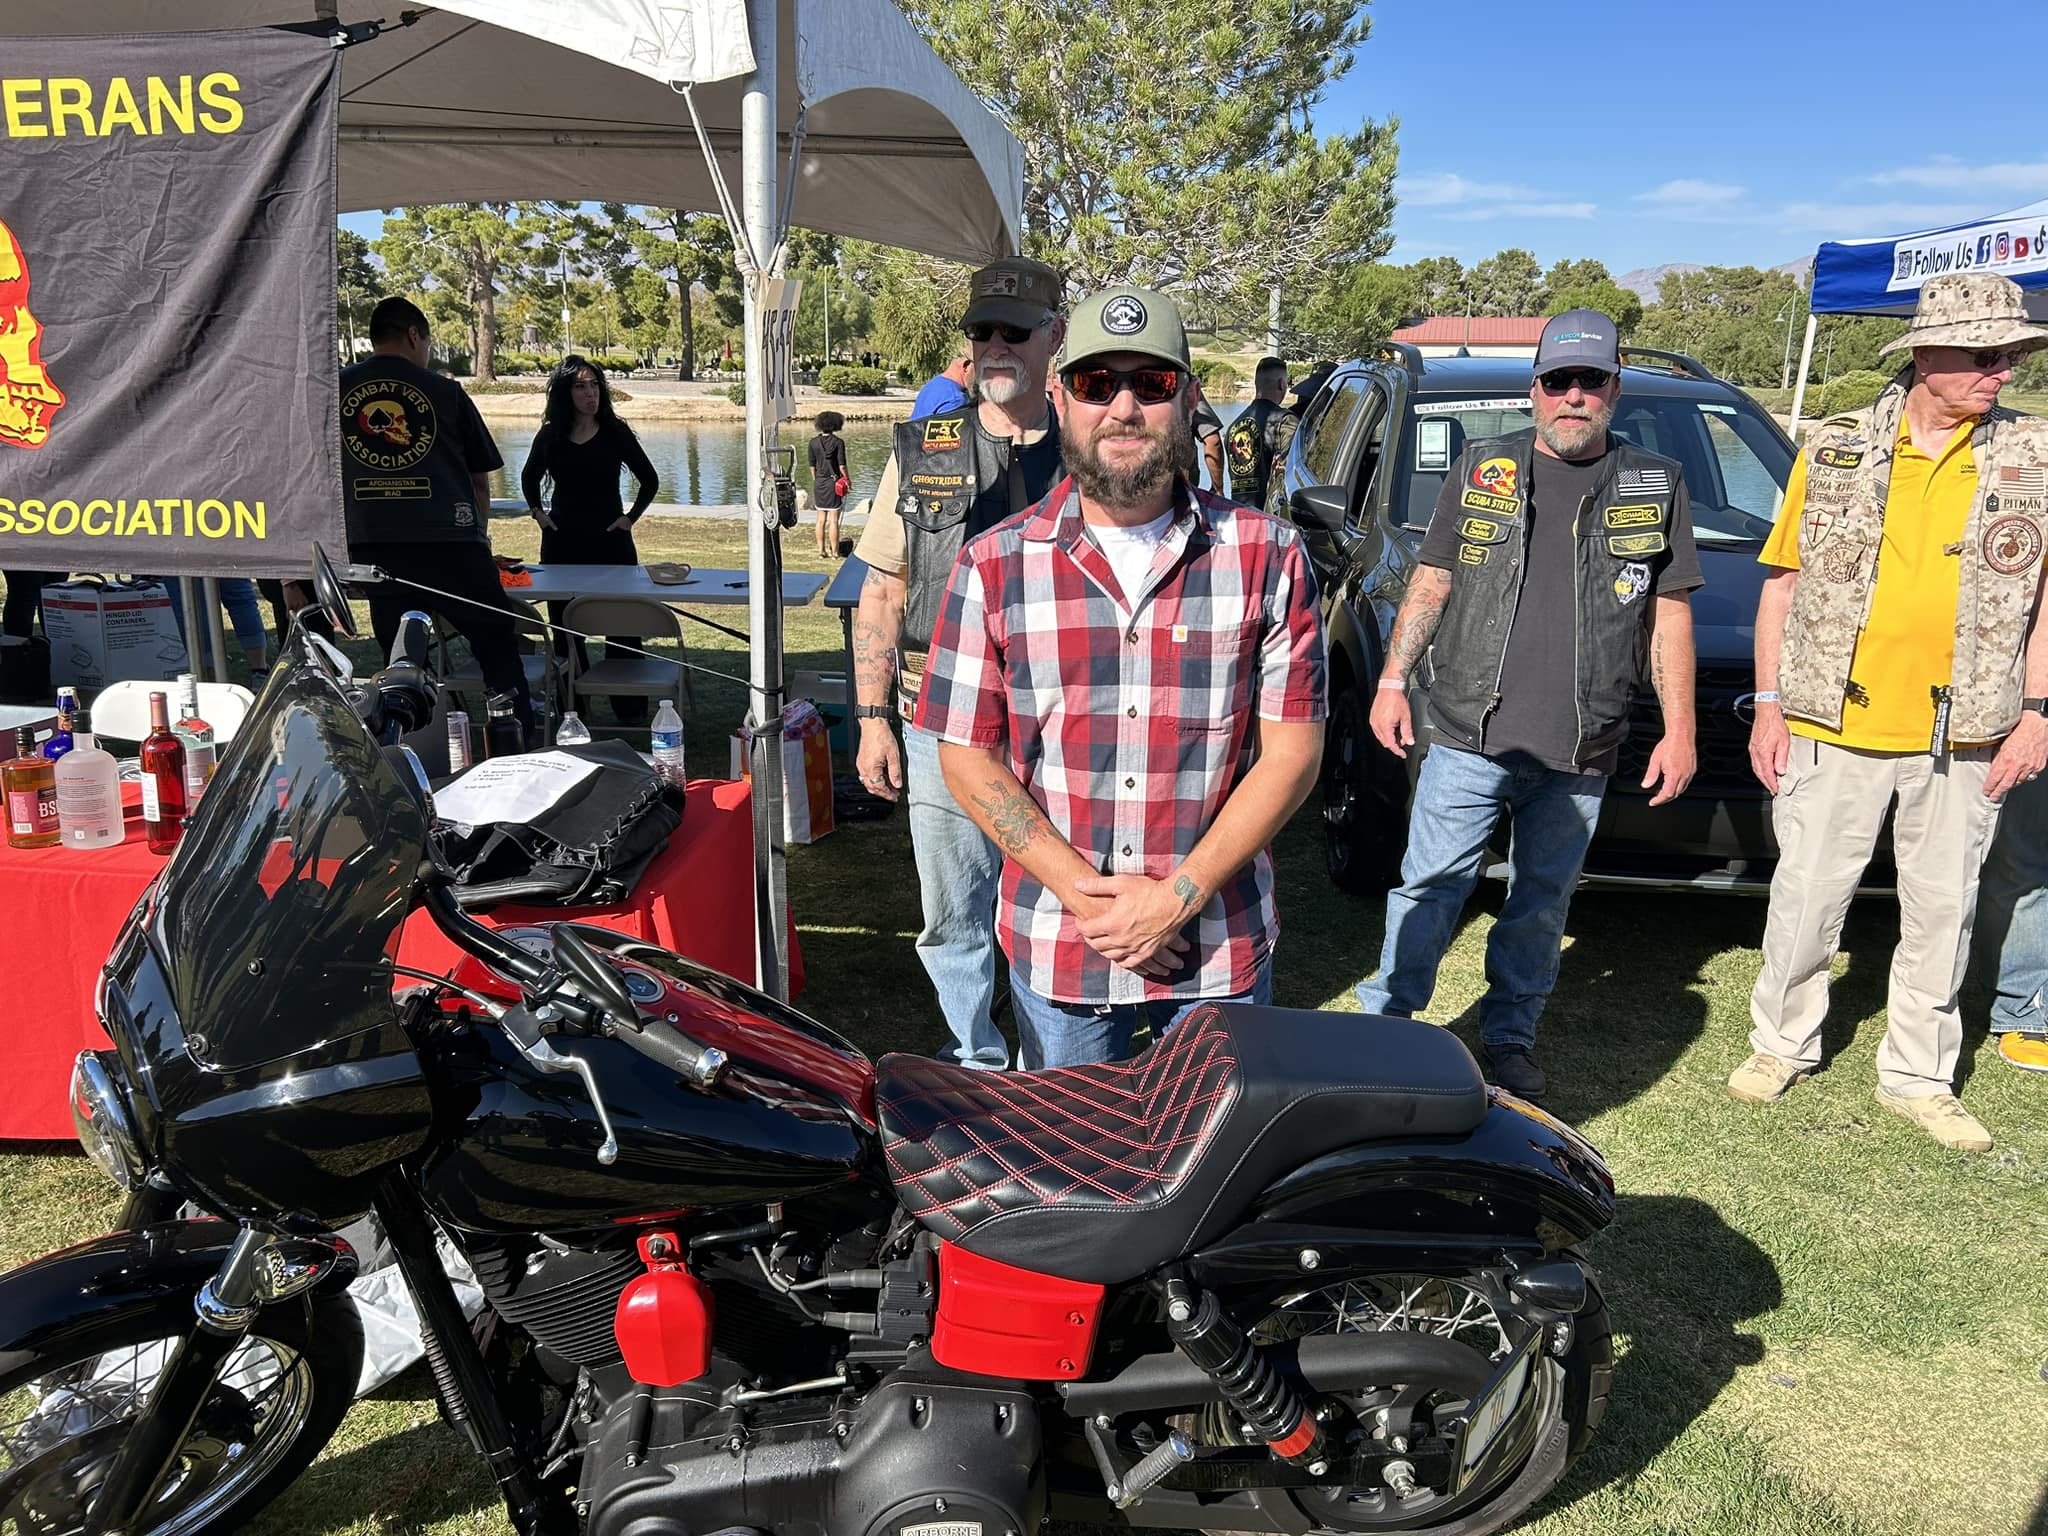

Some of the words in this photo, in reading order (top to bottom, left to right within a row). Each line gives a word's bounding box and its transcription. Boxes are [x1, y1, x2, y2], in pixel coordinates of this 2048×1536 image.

[2, 72, 244, 137] ERANS
[1912, 246, 1954, 277] Follow
[1955, 240, 1973, 270] Us
[342, 382, 399, 417] COMBAT
[402, 386, 430, 414] VETS
[1431, 403, 1463, 412] Follow
[1464, 402, 1478, 410] Us
[346, 431, 433, 467] ASSOCIATION
[1808, 464, 1834, 478] FIRST
[368, 480, 416, 488] AFGHANISTAN
[911, 475, 962, 486] GHOSTRIDER
[384, 489, 402, 498] IRAQ
[1467, 493, 1491, 508] SCUBA
[1491, 498, 1517, 513] STEVE
[2003, 498, 2041, 510] PITMAN
[105, 610, 131, 619] HINGED
[105, 617, 148, 626] CONTAINERS
[38, 800, 59, 818] BS
[904, 1526, 978, 1536] AIRBORNE
